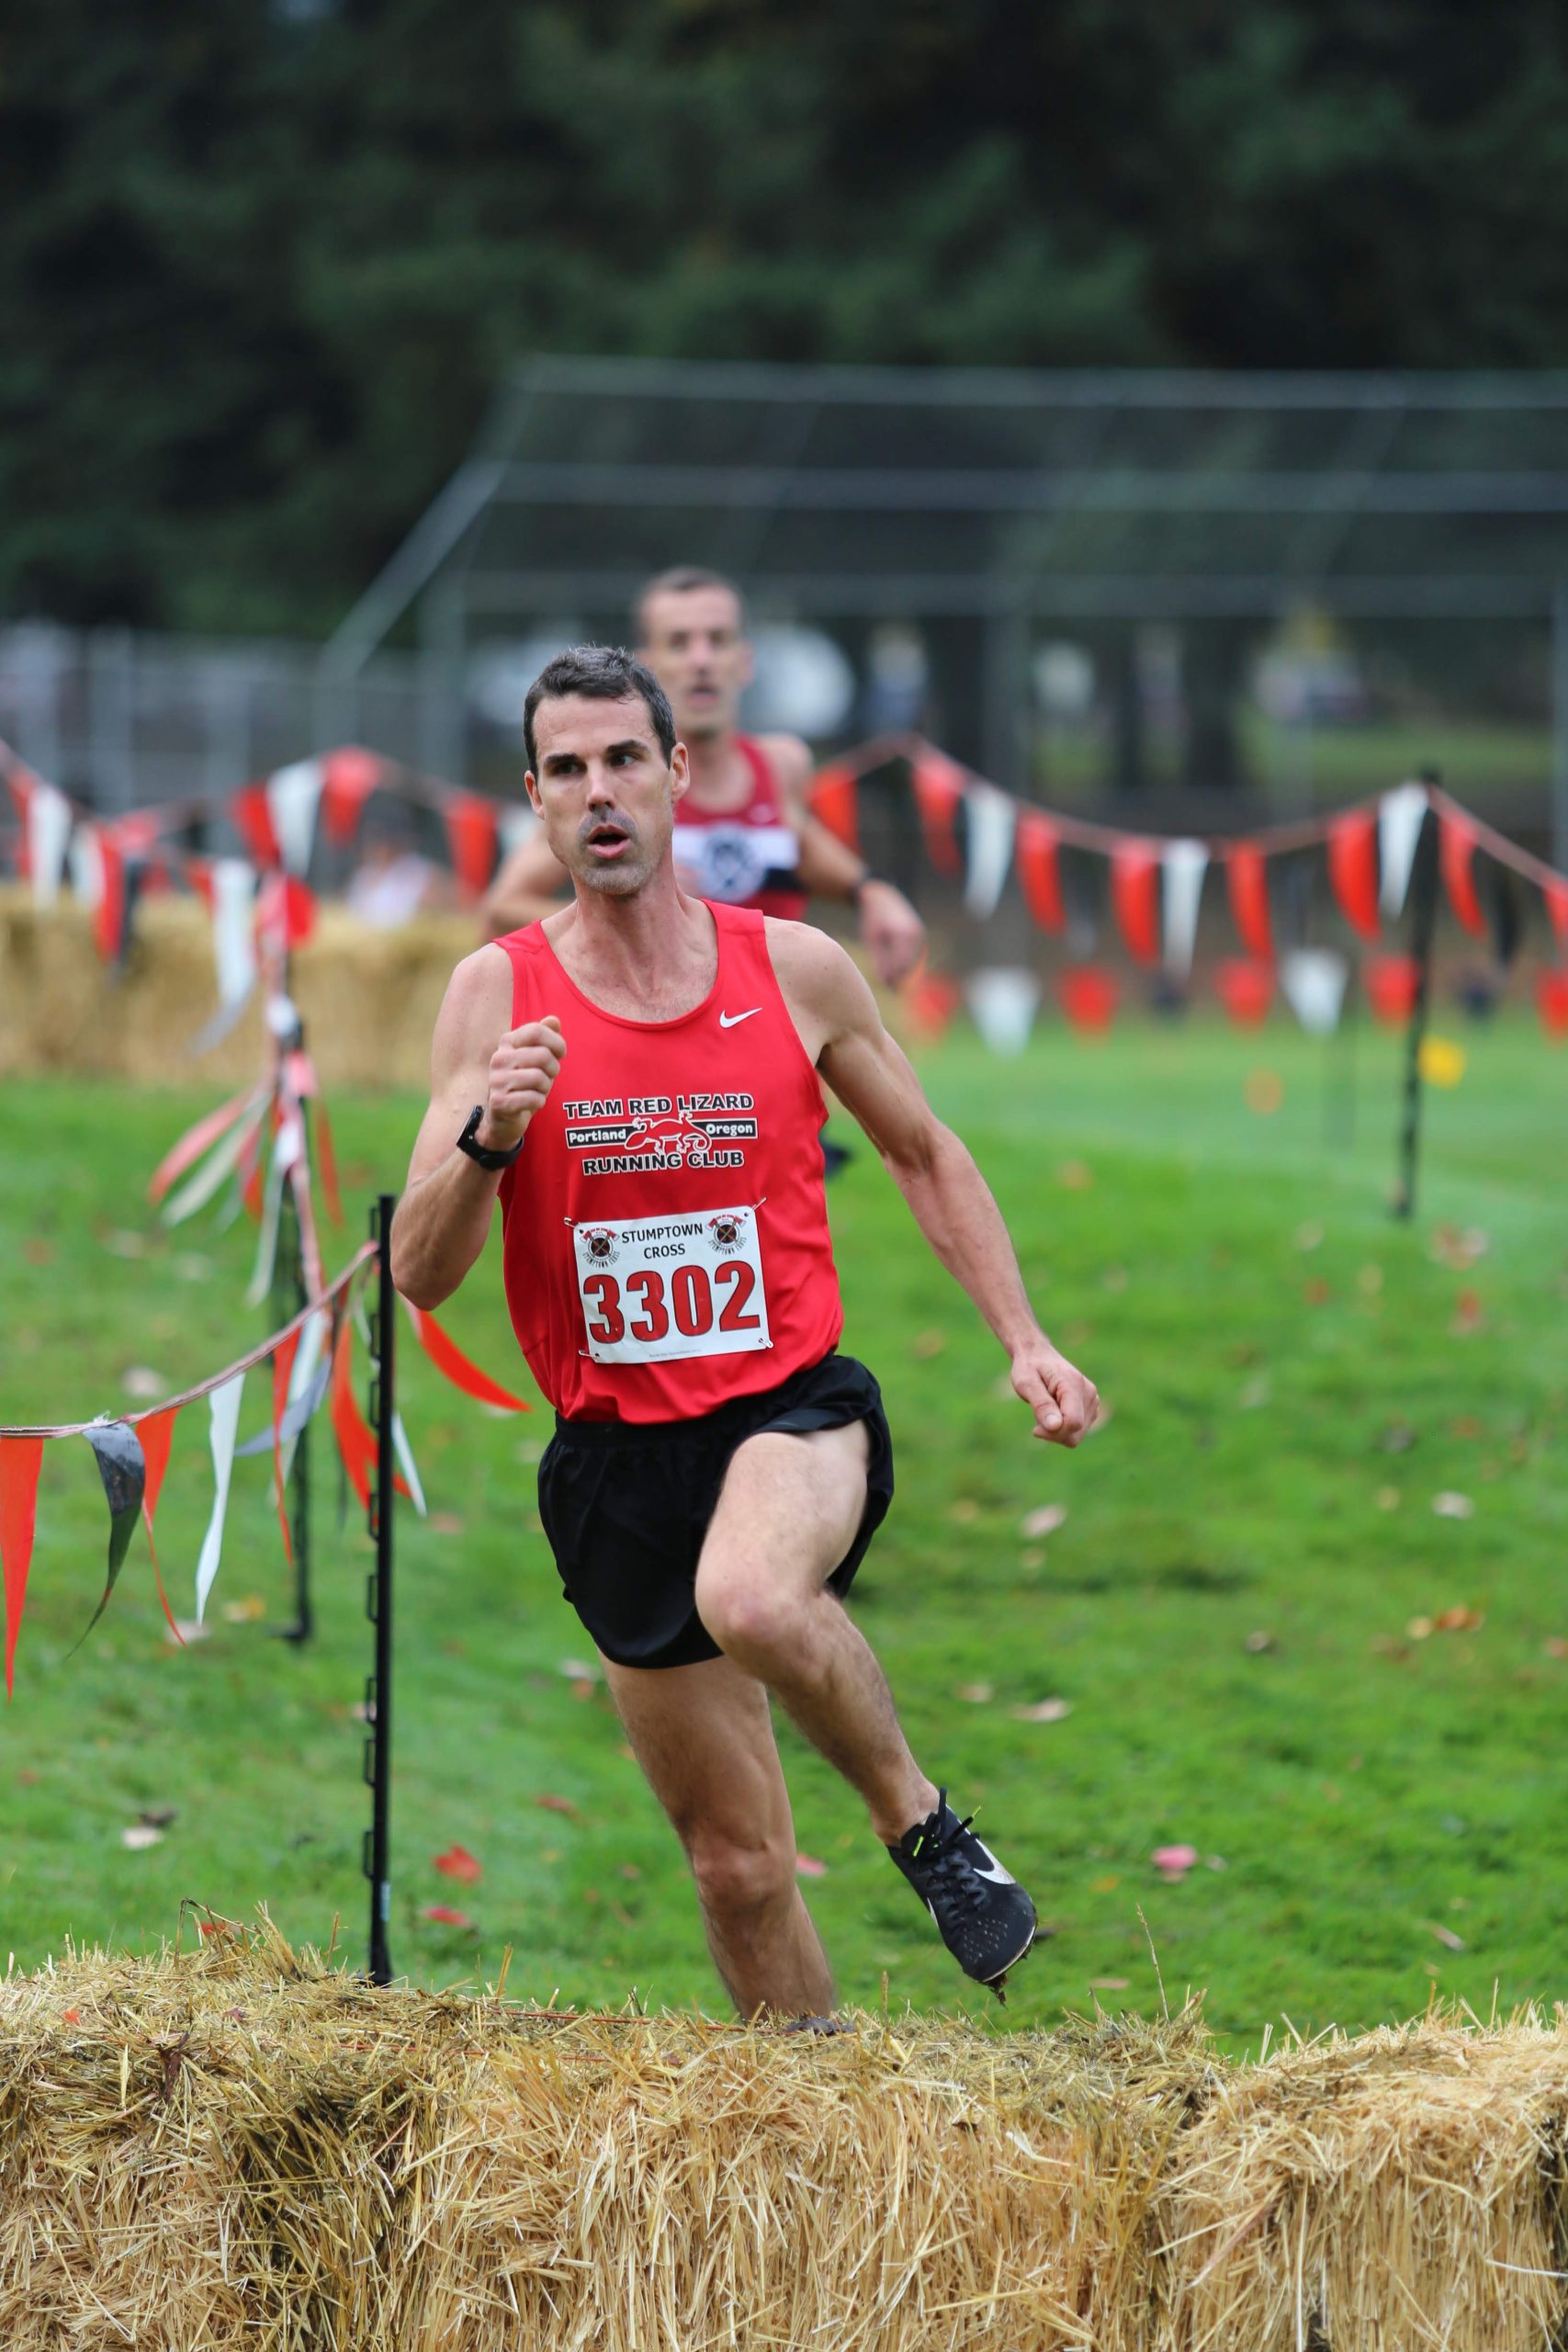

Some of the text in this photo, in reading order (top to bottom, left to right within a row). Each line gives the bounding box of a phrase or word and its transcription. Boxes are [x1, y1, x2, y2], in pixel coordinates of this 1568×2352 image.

[564, 1093, 754, 1120] TEAM RED LIZARD
[569, 1129, 626, 1144] Portland
[705, 1124, 753, 1136] Oregon
[582, 1149, 745, 1176] RUNNING CLUB
[621, 1223, 704, 1244] STUMPTOWN
[643, 1243, 685, 1260] CROSS
[583, 1260, 761, 1344] 3302
